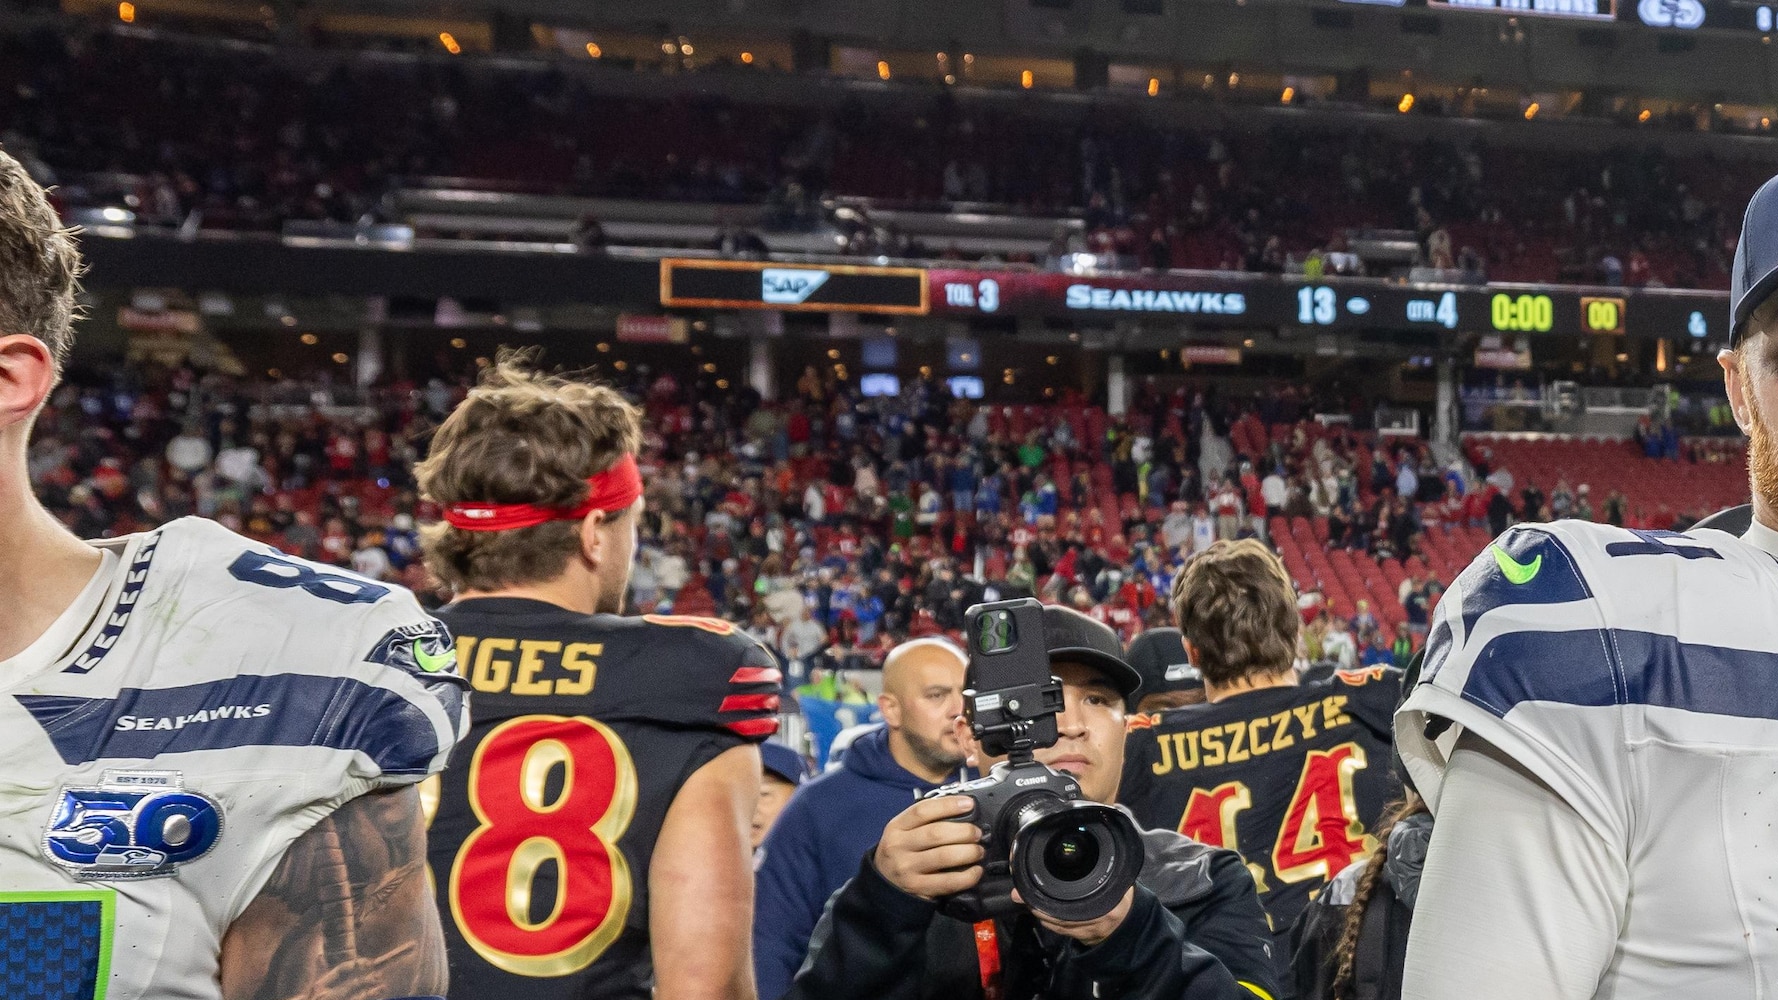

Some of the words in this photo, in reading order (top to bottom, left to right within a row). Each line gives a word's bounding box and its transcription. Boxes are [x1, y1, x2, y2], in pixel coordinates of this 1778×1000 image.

[763, 277, 808, 294] SAP
[978, 279, 999, 313] 3
[1066, 285, 1246, 314] SEAHAWKS
[1298, 286, 1336, 324] 13
[1436, 292, 1458, 328] 4
[1492, 294, 1553, 332] 0:00
[1587, 300, 1618, 330] 00
[115, 703, 271, 732] SEAHAWKS
[1152, 694, 1352, 776] JUSZCZYK
[140, 777, 167, 785] 1976
[1015, 775, 1047, 787] Canon
[420, 714, 639, 978] 8
